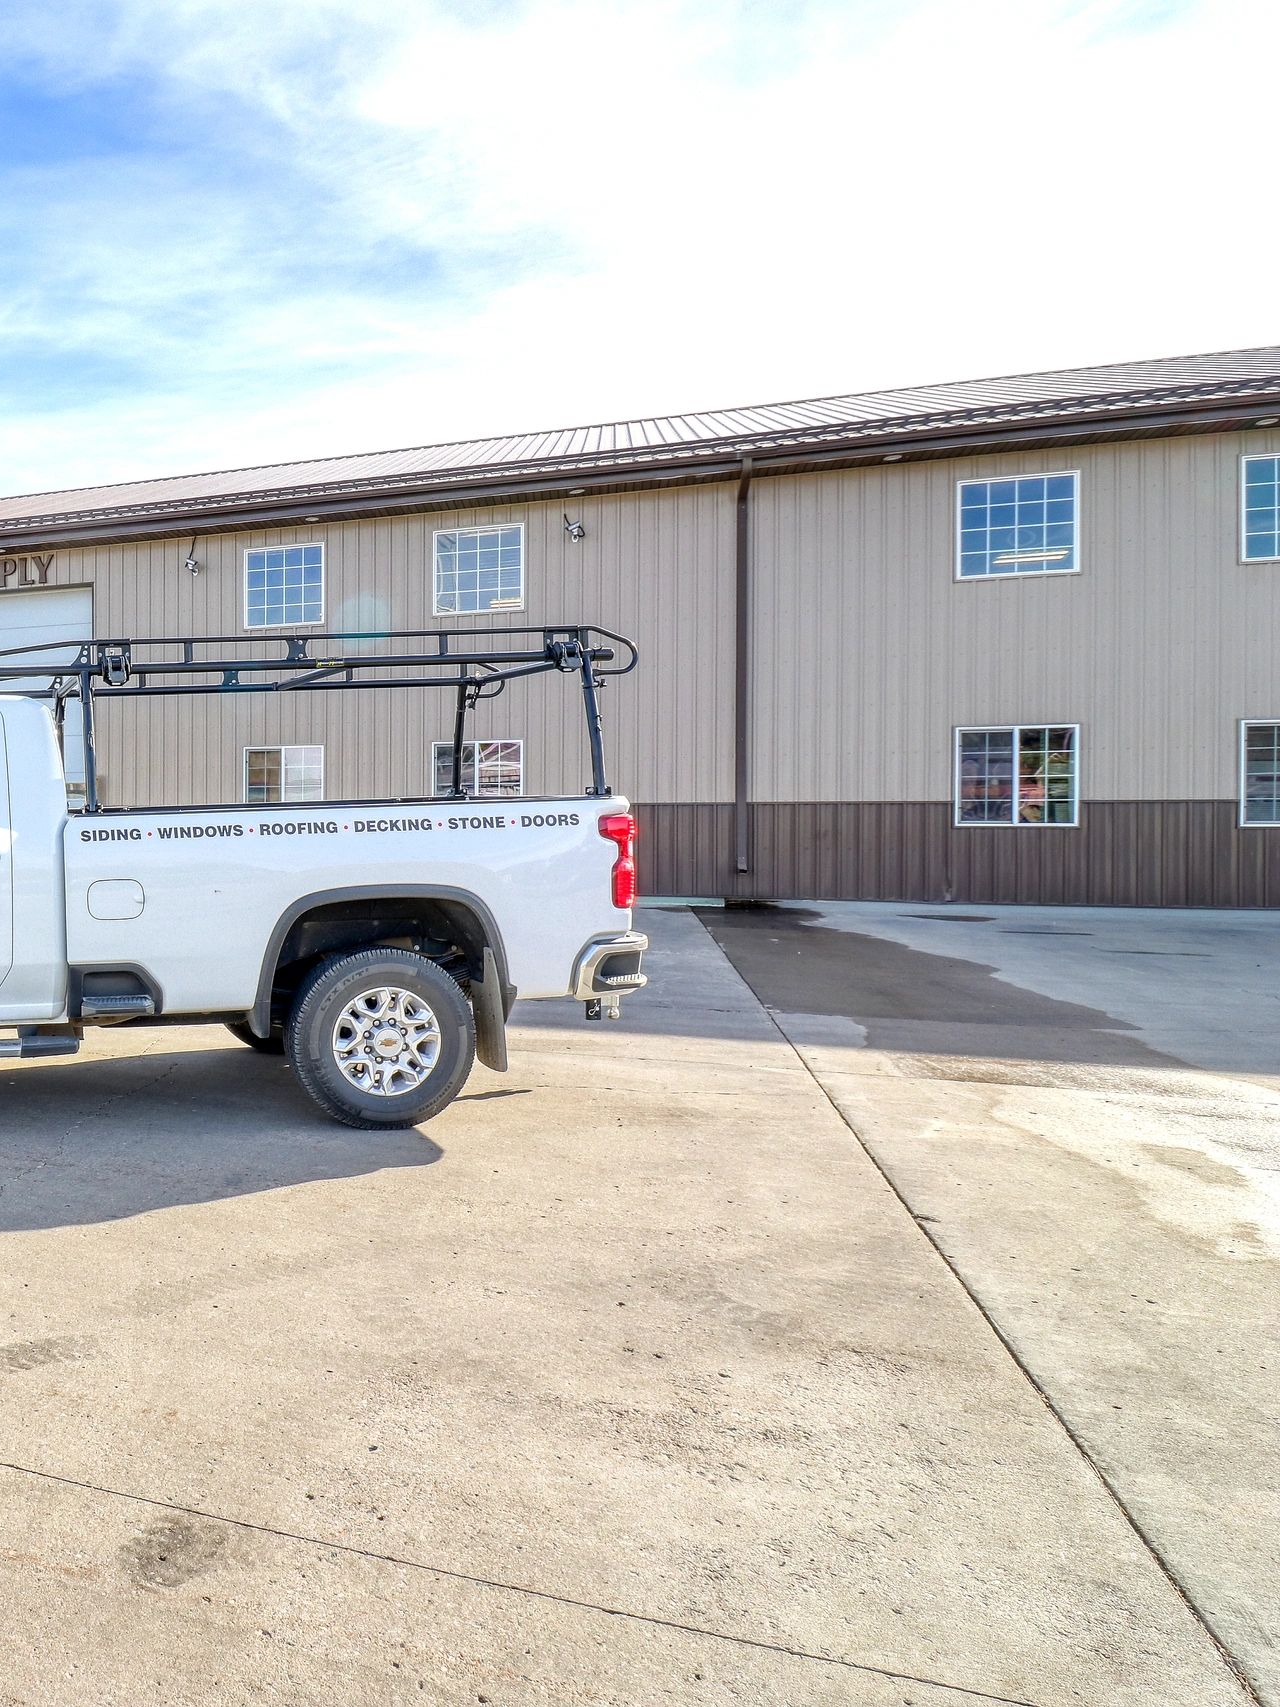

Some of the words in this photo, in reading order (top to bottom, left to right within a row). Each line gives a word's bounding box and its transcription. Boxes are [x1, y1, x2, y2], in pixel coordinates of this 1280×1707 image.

[80, 828, 142, 842] SIDING
[157, 824, 244, 839] WINDOWS
[259, 821, 338, 835] ROOFING
[354, 818, 433, 833] DECKING
[448, 816, 506, 830] STONE
[520, 813, 580, 828] DOORS
